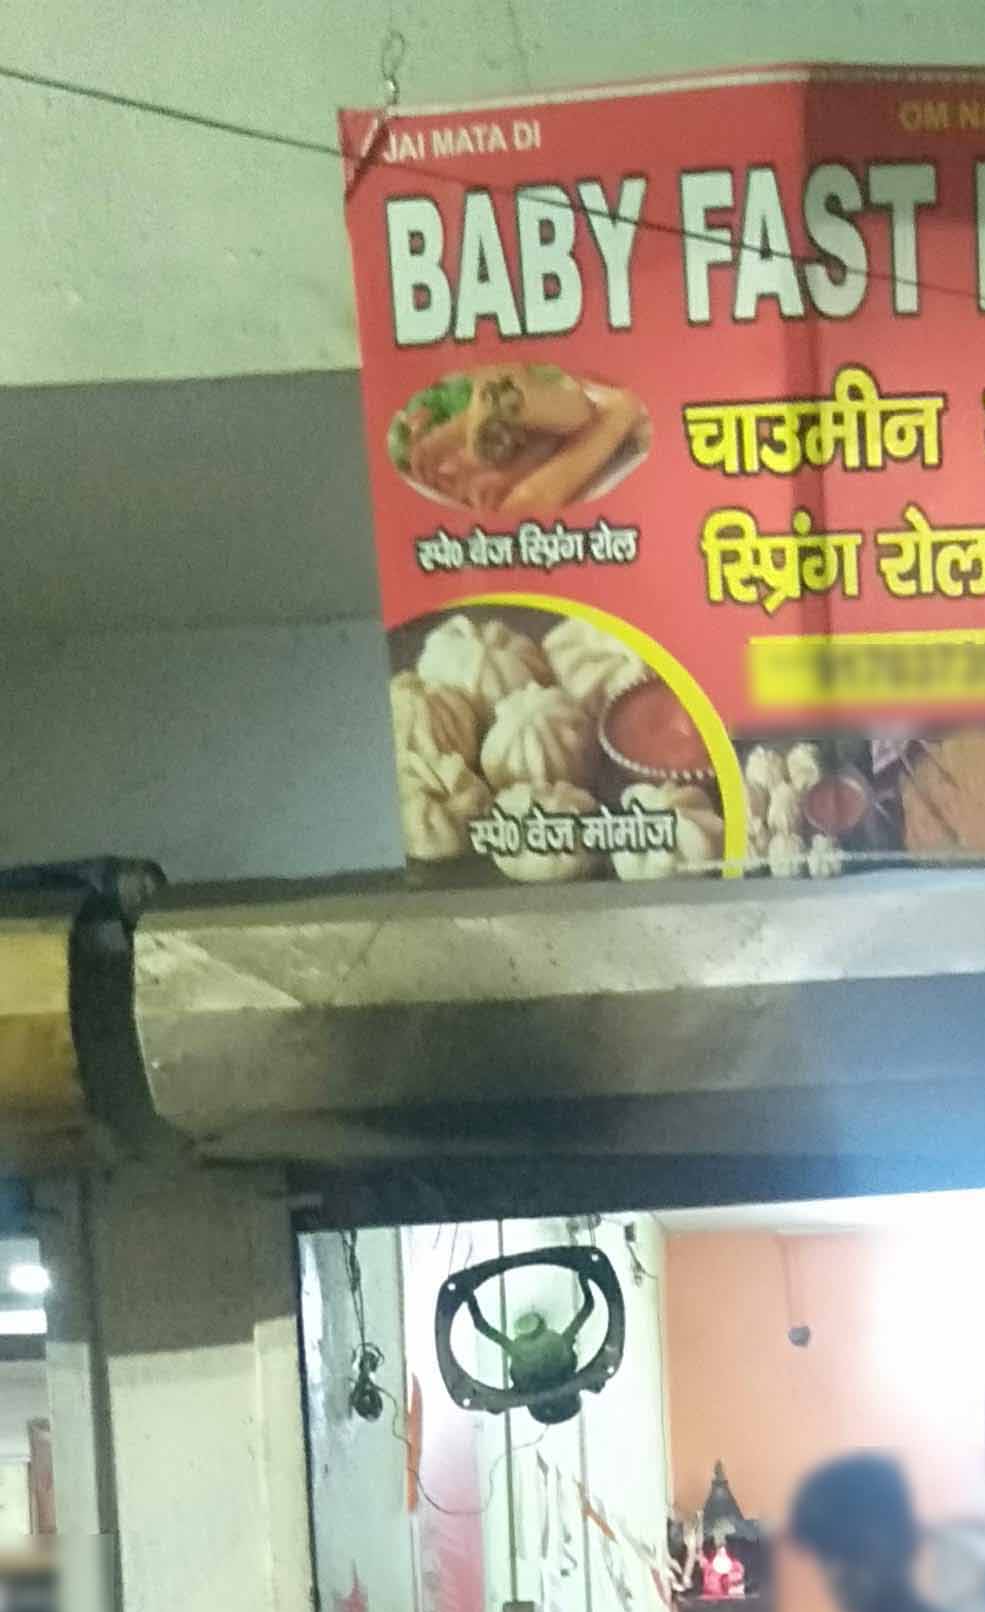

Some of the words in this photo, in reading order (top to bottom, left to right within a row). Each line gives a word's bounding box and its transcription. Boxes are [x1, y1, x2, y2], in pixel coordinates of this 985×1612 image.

[383, 130, 425, 162] JAI
[431, 122, 508, 157] MATA
[512, 119, 541, 149] DI
[899, 102, 949, 130] OM
[385, 175, 647, 347] BABY
[680, 161, 937, 325] FAST
[684, 364, 945, 476] चाउमीन
[467, 526, 514, 567] वेज
[588, 517, 638, 562] रोल
[700, 507, 862, 615] स्प्रिंग
[525, 804, 576, 851] वेज
[580, 803, 675, 851] मोमोज
